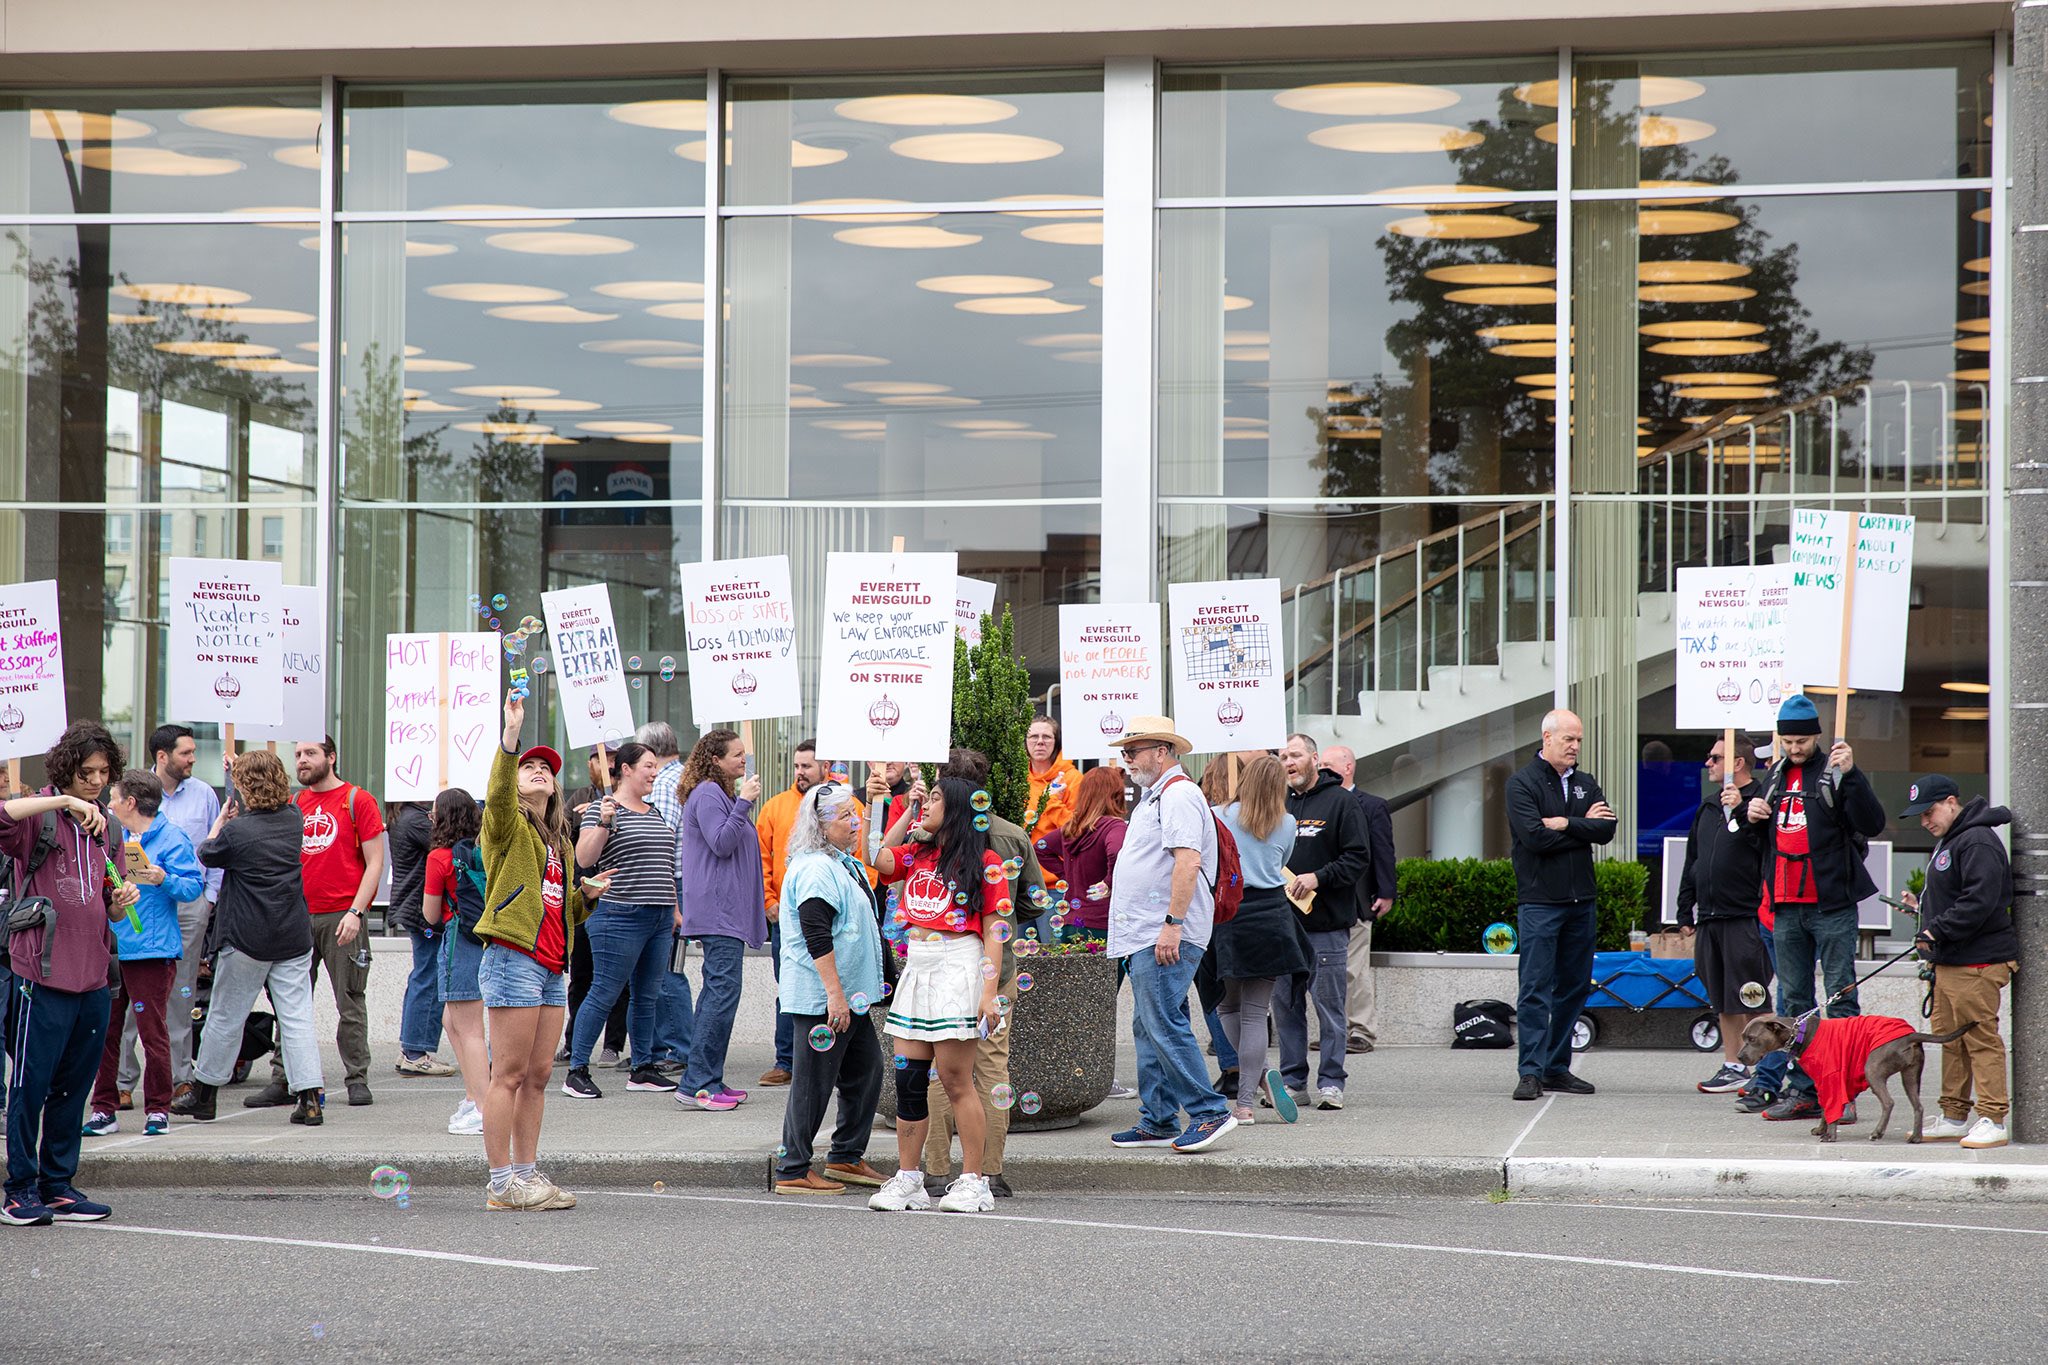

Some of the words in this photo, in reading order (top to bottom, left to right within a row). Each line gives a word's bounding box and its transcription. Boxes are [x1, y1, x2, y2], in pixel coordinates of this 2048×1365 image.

[1795, 532, 1833, 549] WHAT
[199, 582, 251, 591] EVERETT
[711, 581, 760, 592] EVERETT
[860, 582, 921, 592] EVERETT
[193, 591, 261, 602] NEWSGUILD
[705, 591, 771, 602] NEWSGUILD
[1704, 590, 1746, 598] EVERET
[1762, 588, 1789, 597] EVERETT
[852, 595, 931, 605] NEWSGUILD
[1699, 600, 1745, 608] NEWSGU
[0, 608, 27, 618] RETT
[561, 608, 592, 620] EVERETT
[1198, 605, 1250, 615] EVERETT
[0, 617, 38, 629] GUILD
[560, 617, 600, 630] NEWSGUILD
[833, 611, 851, 623] We
[890, 611, 914, 625] your
[1192, 614, 1260, 626] NEWSGUILD
[840, 627, 870, 641] LAW
[874, 621, 949, 640] ENFORCEMENT
[1085, 626, 1132, 634] EVERETT
[557, 626, 614, 655] EXTRA!
[727, 630, 737, 648] 4
[1080, 635, 1141, 643] NEWSGUILD
[197, 653, 214, 662] ON
[217, 655, 259, 664] STRIKE
[389, 639, 431, 669] HOT
[450, 639, 494, 671] People
[712, 653, 729, 662] ON
[732, 651, 772, 661] STRIKE
[1063, 650, 1080, 663] We
[1103, 647, 1148, 660] PEOPLE
[0, 655, 47, 674] essary
[282, 652, 321, 674] NEWS
[562, 648, 619, 679] EXTRA!
[1719, 660, 1747, 668] STRI
[1759, 661, 1769, 669] ON
[850, 673, 869, 682] ON
[873, 673, 923, 683] STRIKE
[1065, 669, 1087, 680] not
[1091, 665, 1153, 681] NUMBERS
[573, 679, 583, 688] ON
[585, 674, 609, 686] STRIKE
[1198, 681, 1215, 690] ON
[1218, 679, 1260, 689] STRIKE
[386, 686, 437, 713] Support
[453, 685, 492, 710] Free
[1083, 693, 1098, 701] ON
[1101, 692, 1139, 701] STRIKE
[389, 720, 437, 744] Press
[910, 899, 940, 909] EVERETT
[1455, 1014, 1490, 1033] SUNDA
